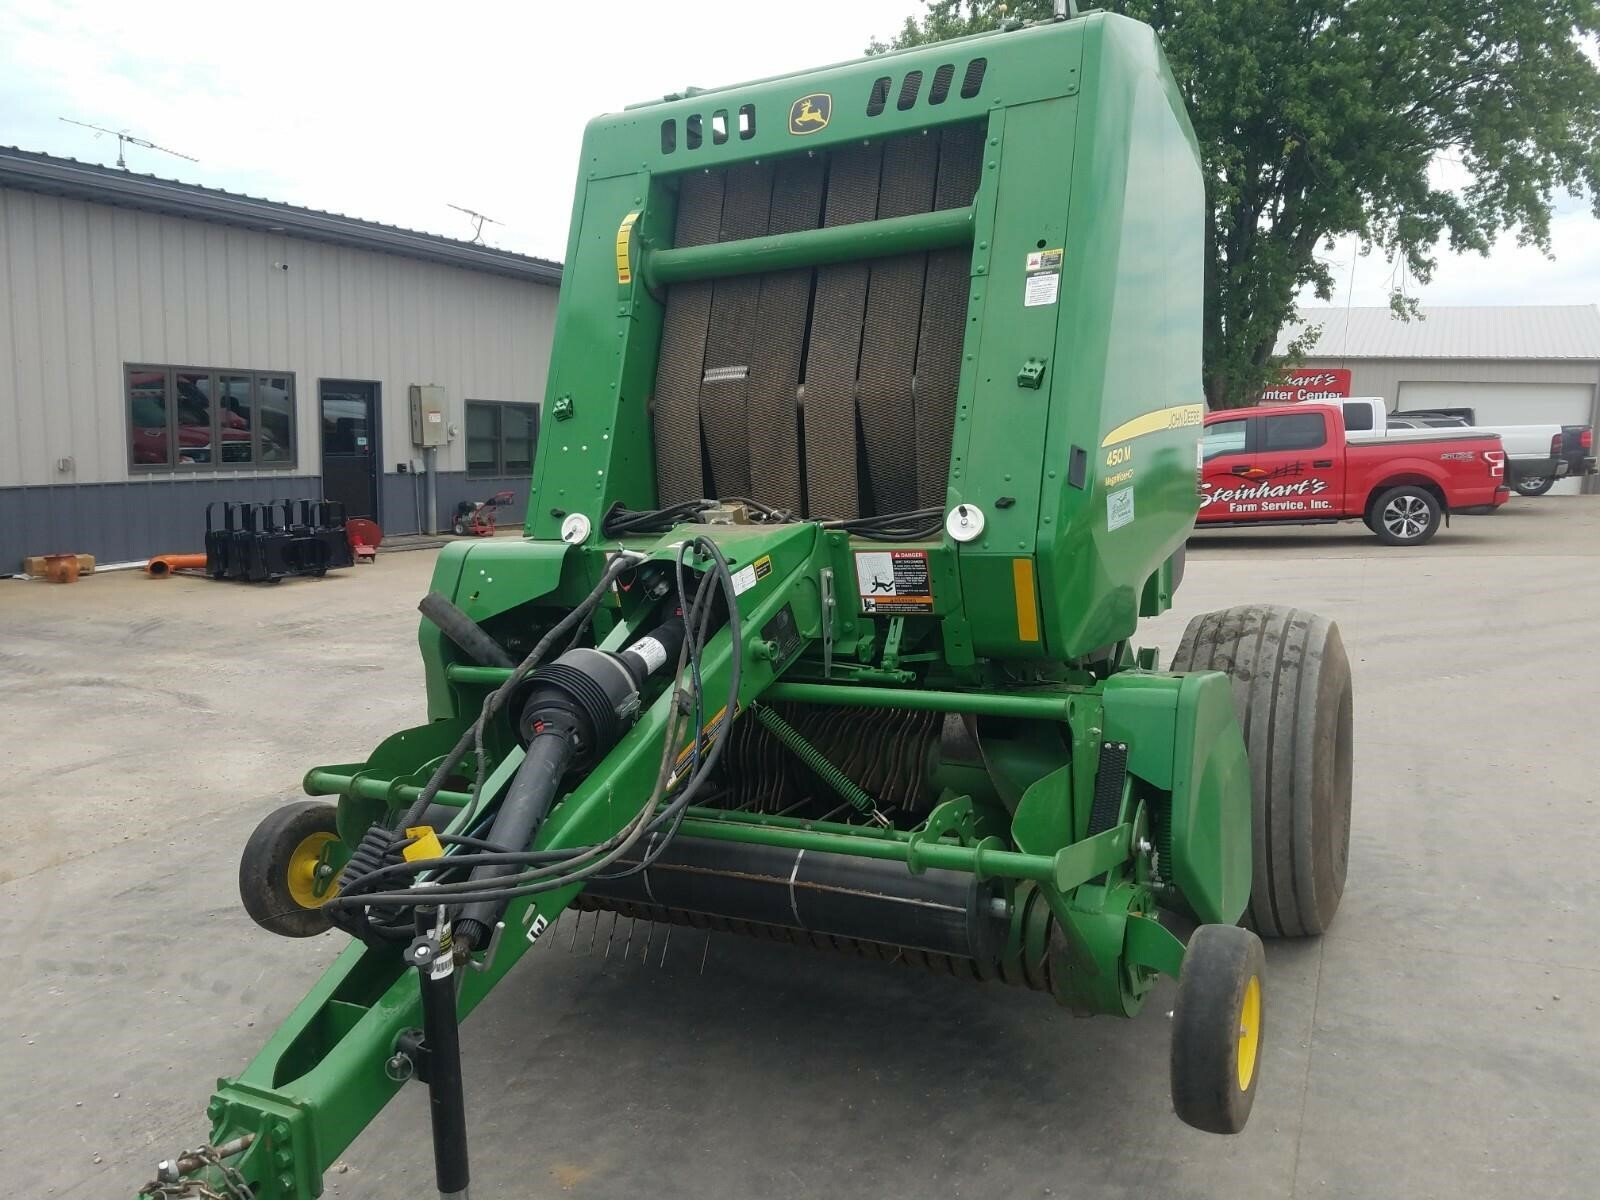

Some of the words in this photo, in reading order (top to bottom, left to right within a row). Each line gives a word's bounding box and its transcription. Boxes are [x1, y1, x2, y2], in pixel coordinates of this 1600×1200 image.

[1297, 389, 1342, 400] Center
[1106, 447, 1123, 467] 450
[1199, 479, 1328, 508] Steinhart's
[1229, 502, 1257, 512] Farm
[1261, 500, 1307, 511] Service,
[1310, 499, 1332, 509] Inc.
